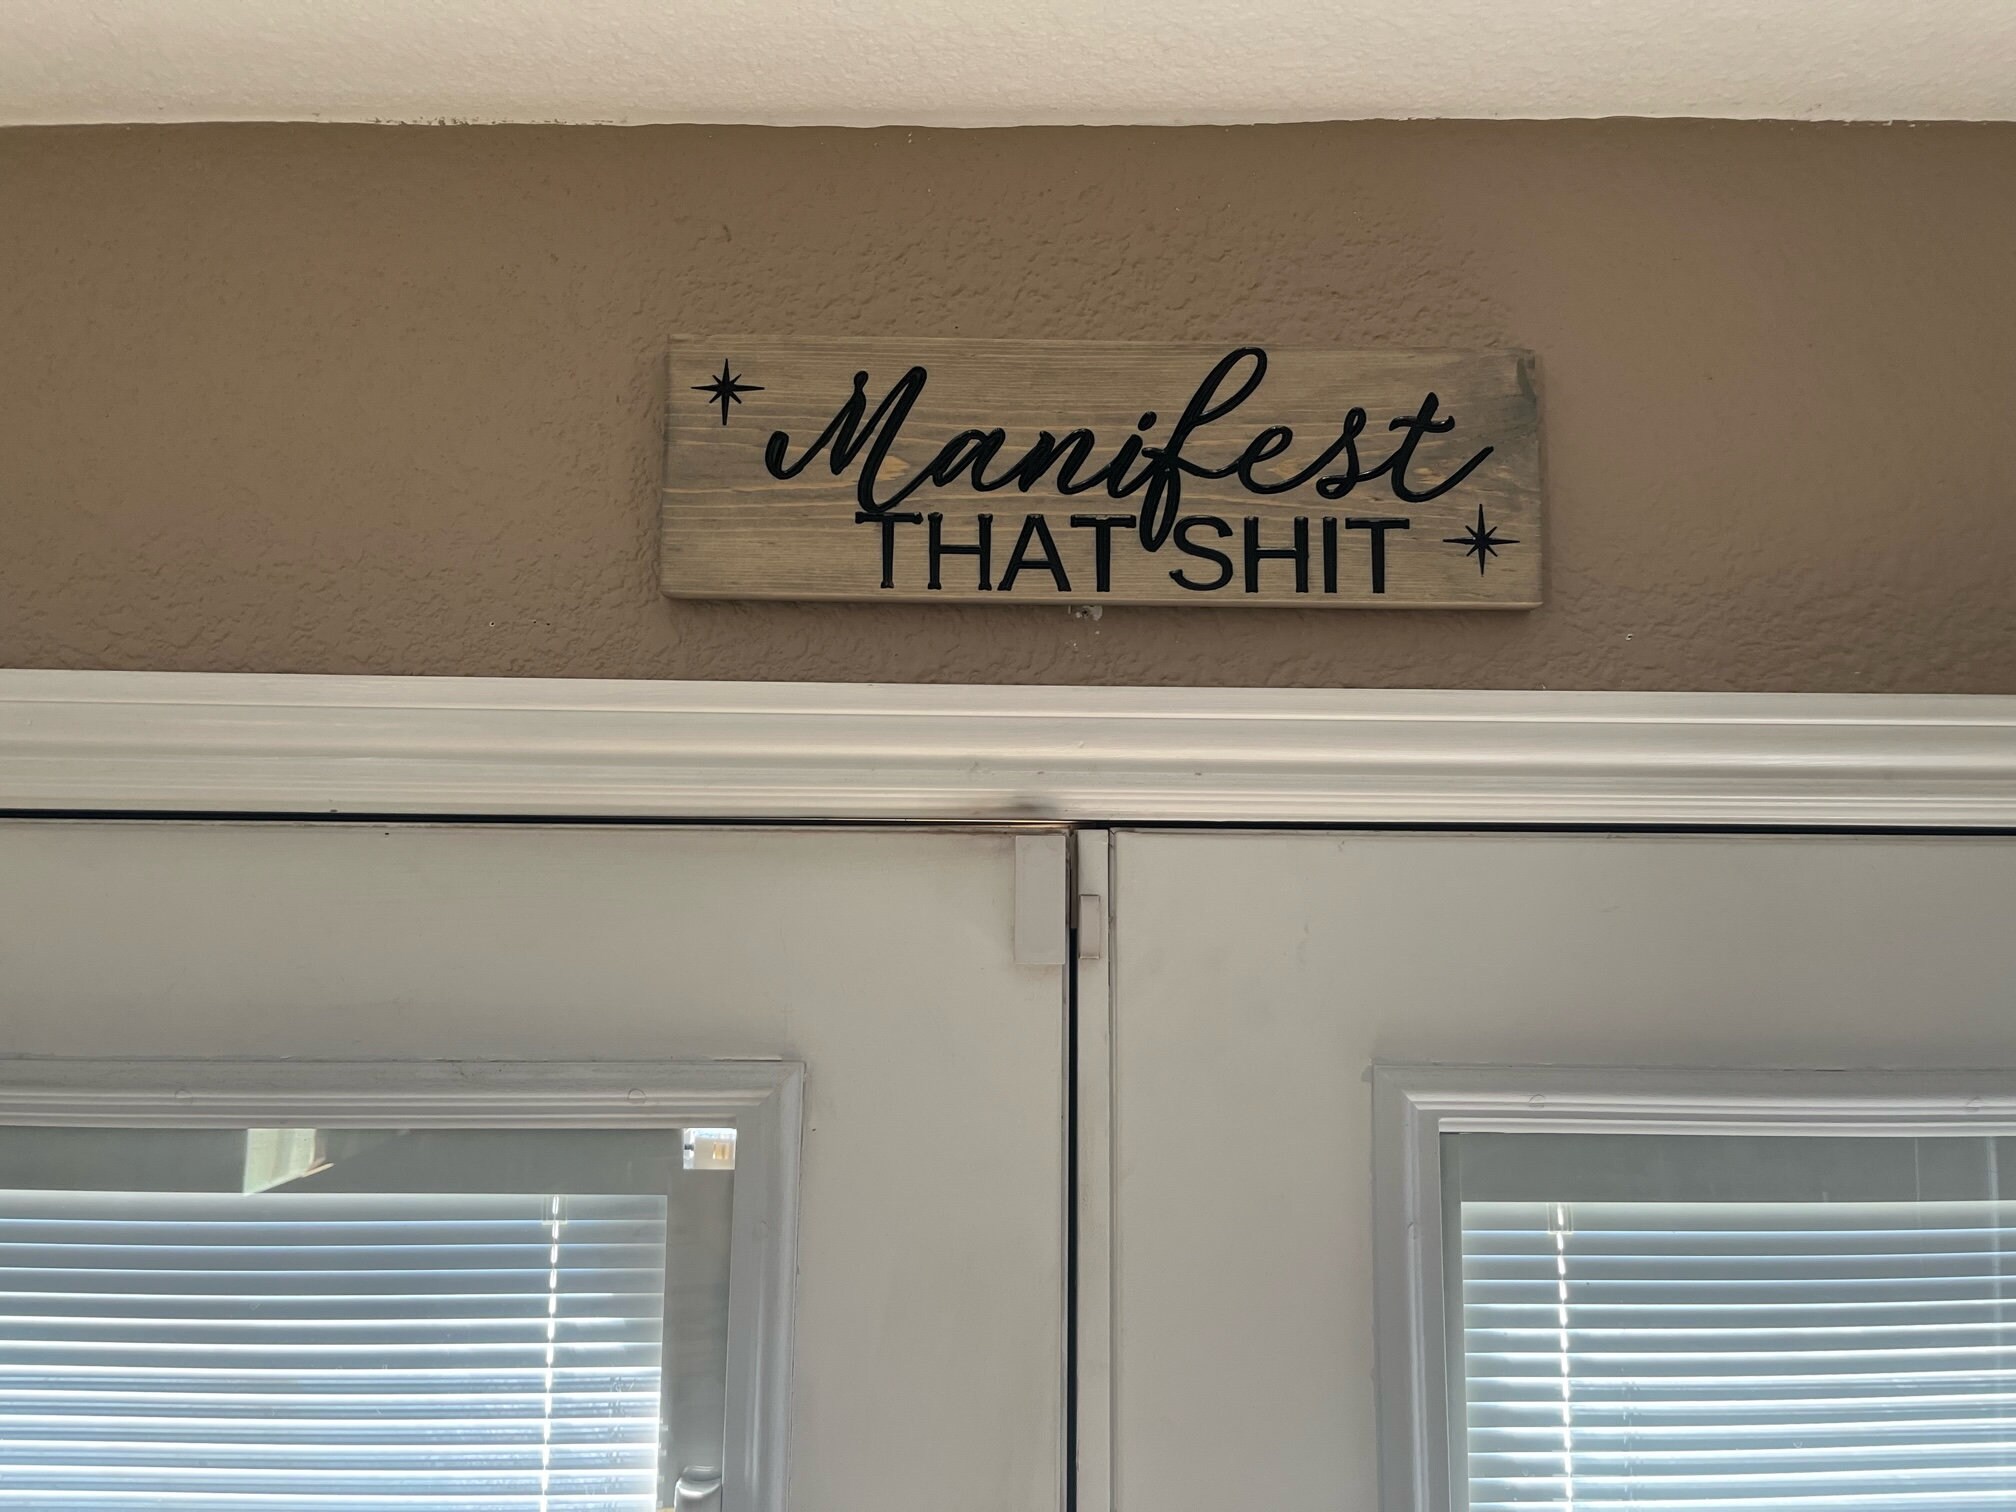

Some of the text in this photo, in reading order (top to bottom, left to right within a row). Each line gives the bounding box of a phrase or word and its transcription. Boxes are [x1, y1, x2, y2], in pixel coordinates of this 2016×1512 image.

[764, 346, 1495, 552] Manifest
[854, 511, 1411, 594] THAT SHIT
